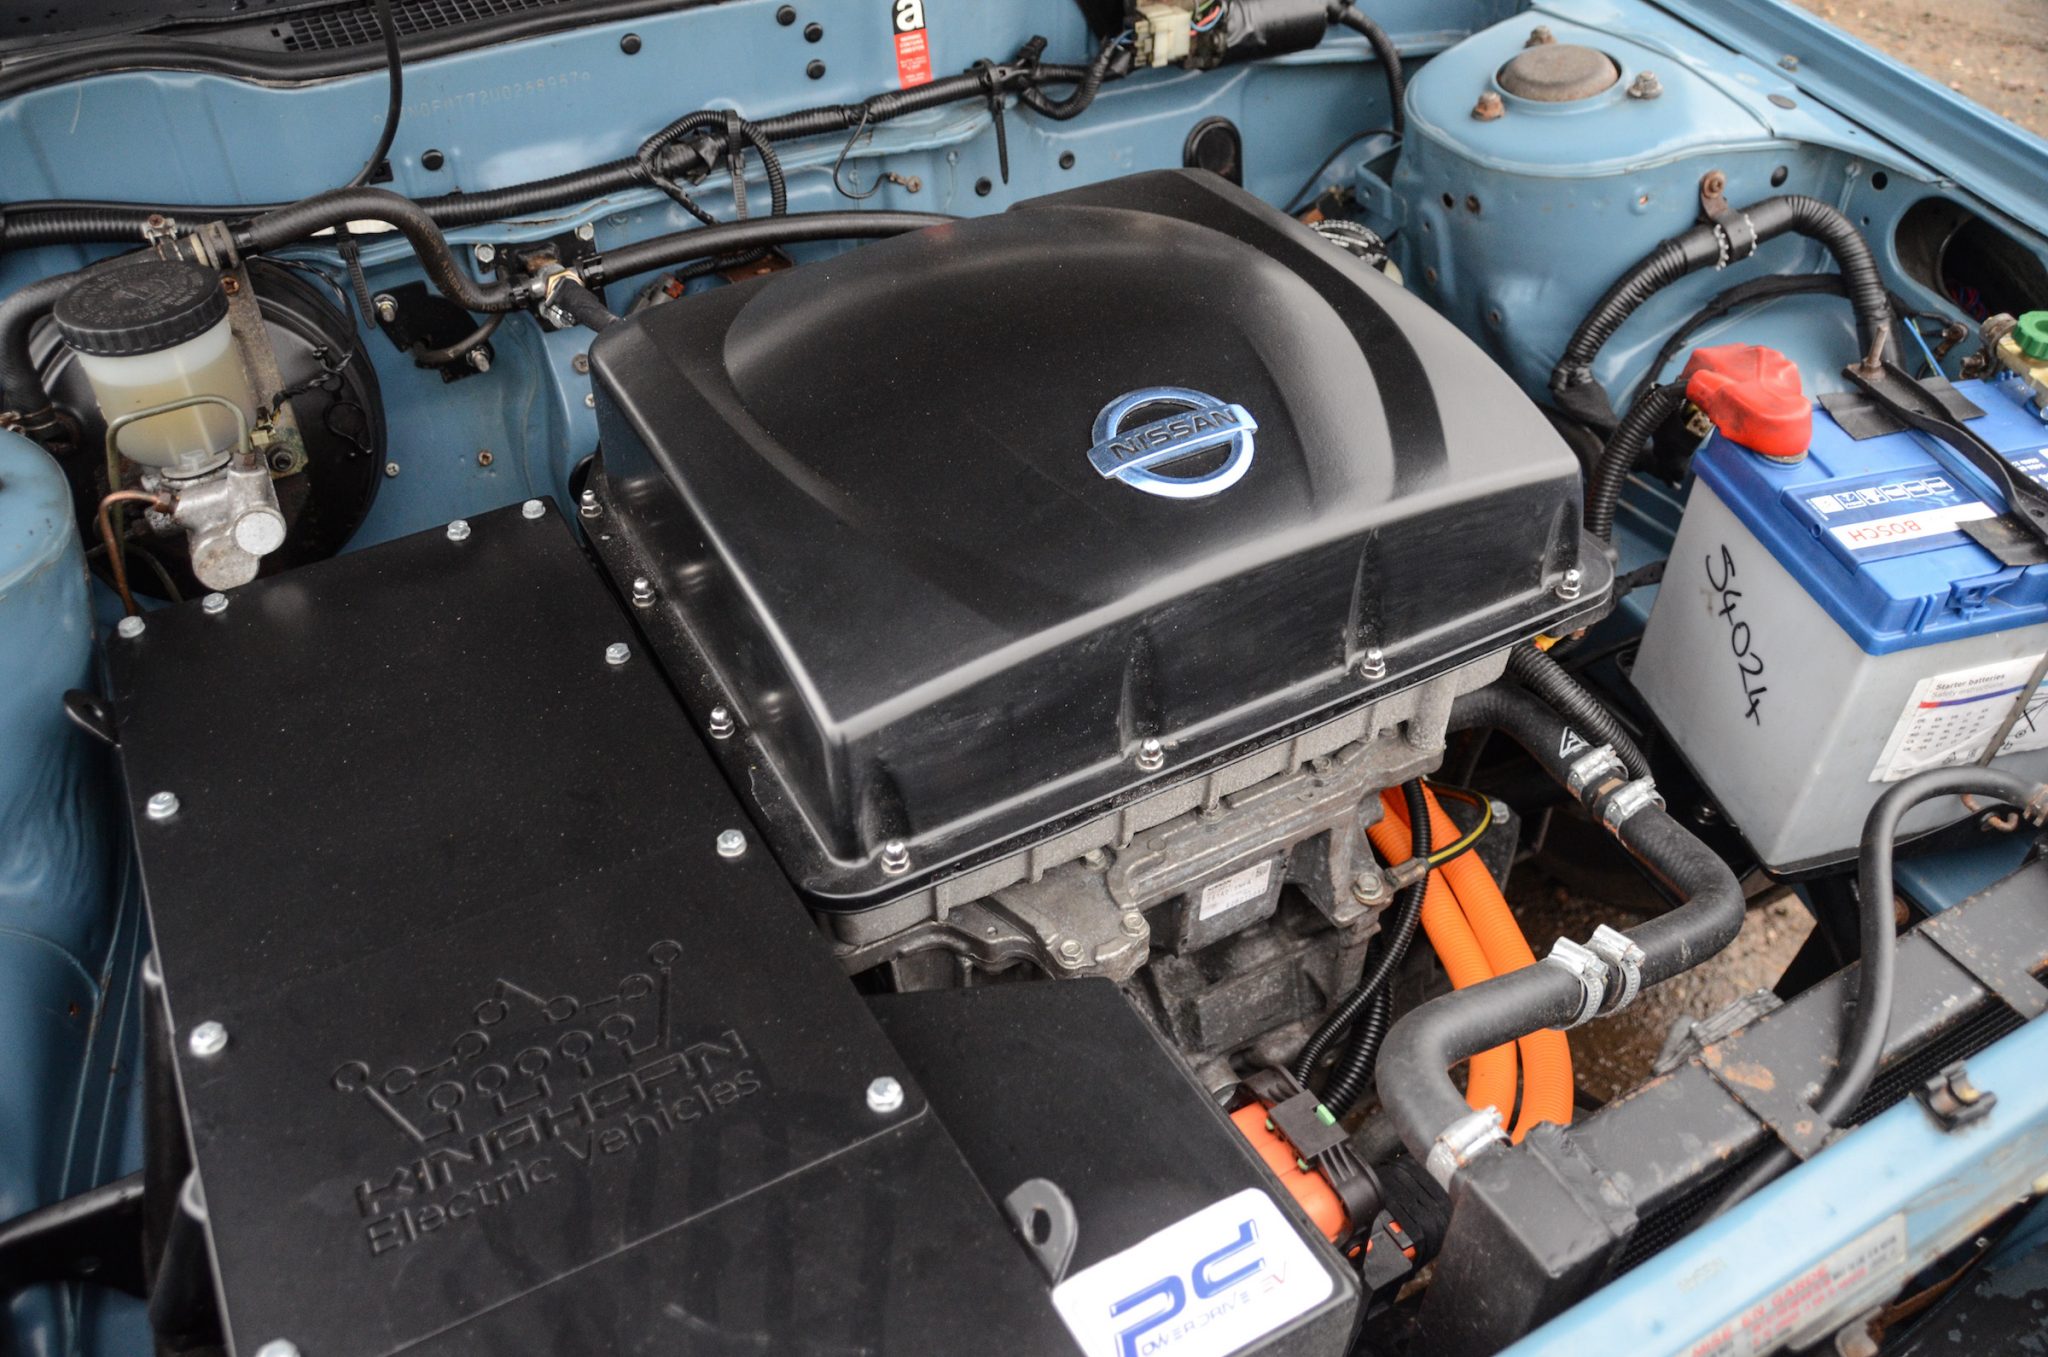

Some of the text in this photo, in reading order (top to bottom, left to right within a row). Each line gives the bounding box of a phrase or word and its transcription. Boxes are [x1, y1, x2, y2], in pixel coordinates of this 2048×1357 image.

[897, 0, 925, 31] a
[1108, 408, 1240, 461] NISSAN
[1848, 520, 1921, 543] BOSCH
[1705, 543, 1768, 727] S4024
[1935, 673, 2006, 691] Starter batteries
[366, 1068, 762, 1258] Electric Vehicles
[1260, 1261, 1288, 1294] EV
